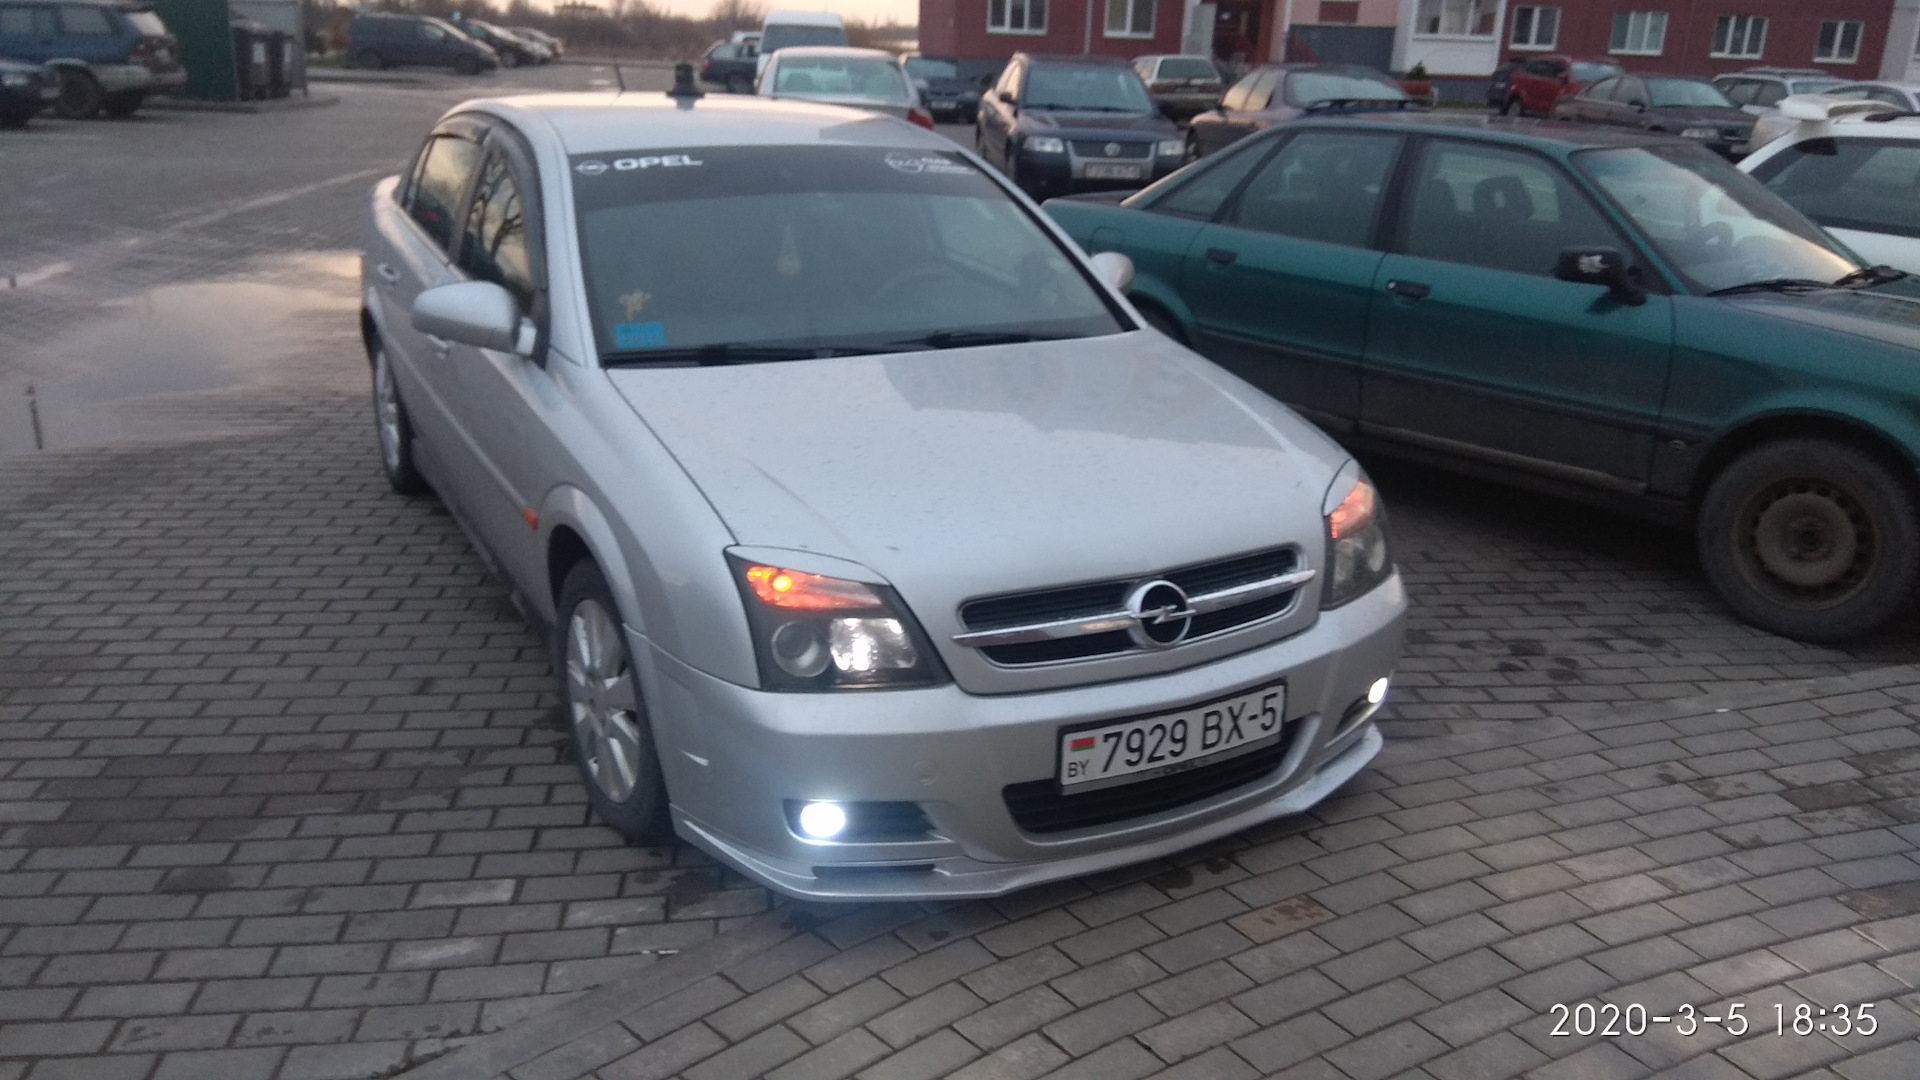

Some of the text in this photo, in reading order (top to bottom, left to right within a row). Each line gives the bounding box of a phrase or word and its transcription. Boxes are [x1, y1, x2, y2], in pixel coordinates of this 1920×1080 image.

[613, 154, 703, 171] OPEL
[1102, 692, 1279, 772] 7929 BX-5
[1068, 759, 1090, 778] BY
